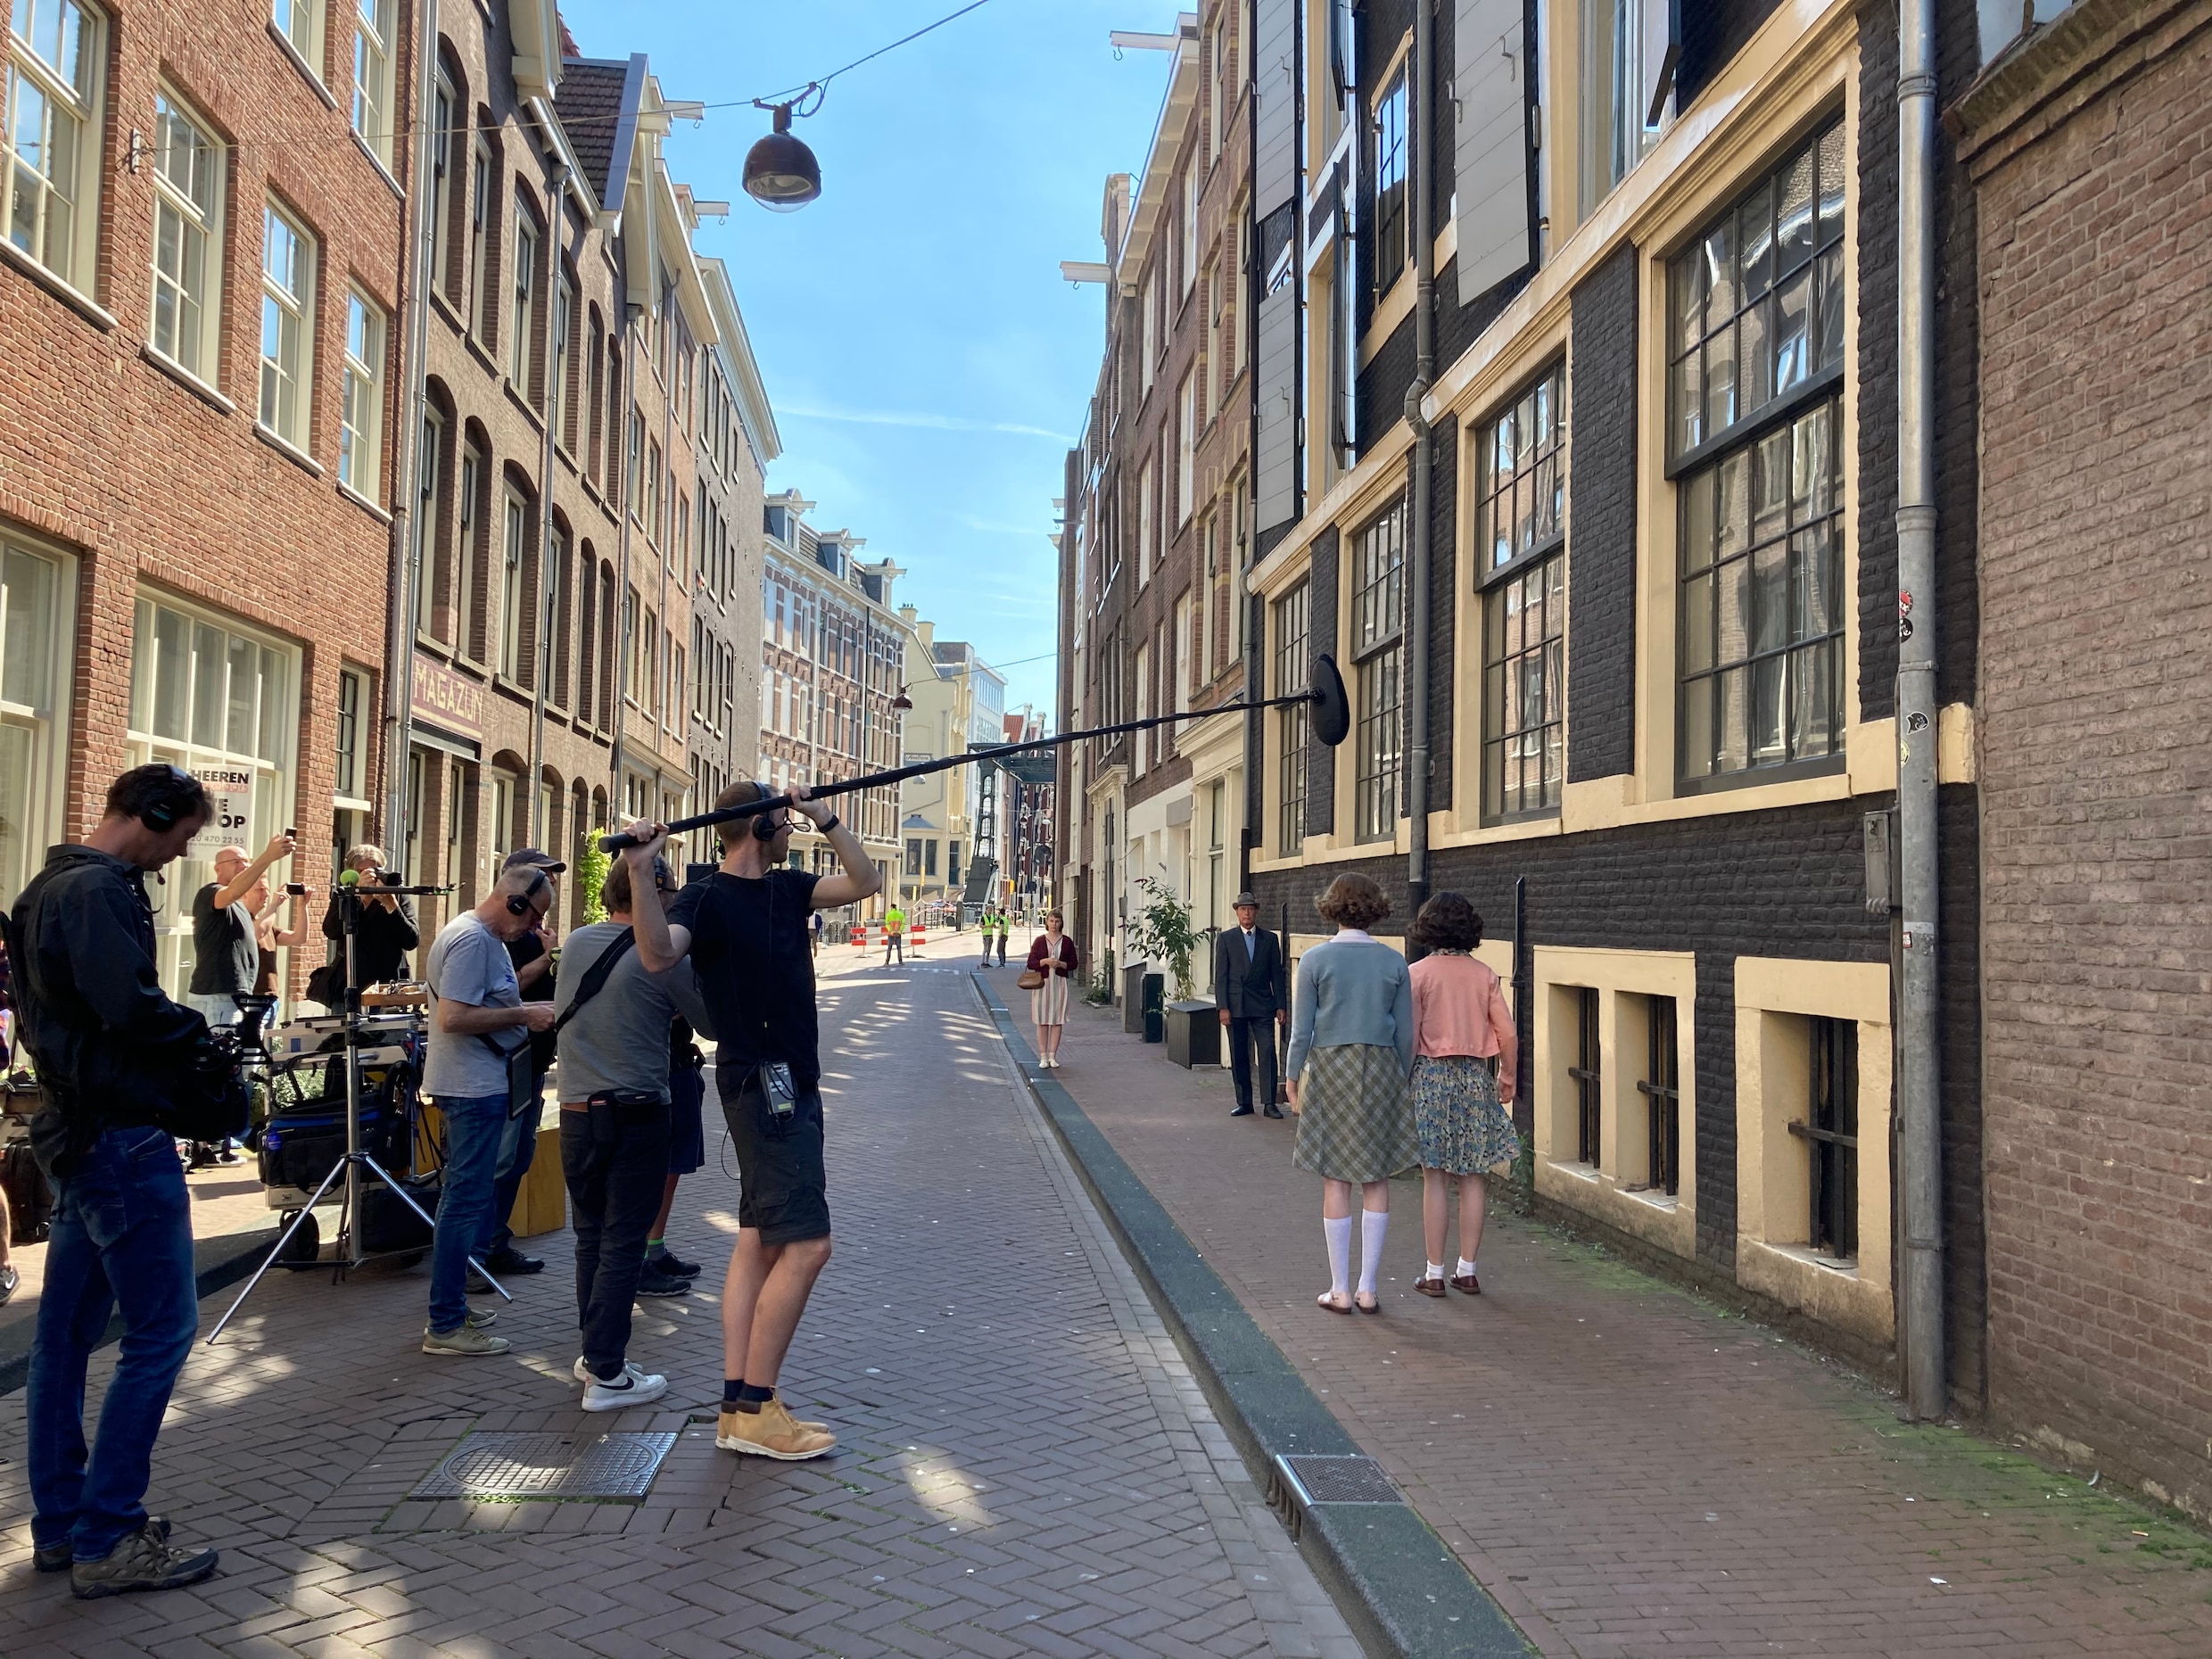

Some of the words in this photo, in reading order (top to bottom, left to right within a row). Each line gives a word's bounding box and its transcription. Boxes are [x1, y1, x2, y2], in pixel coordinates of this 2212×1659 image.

[414, 660, 483, 725] MAGAZIJN
[192, 770, 250, 784] HEEREN
[217, 814, 246, 829] OP
